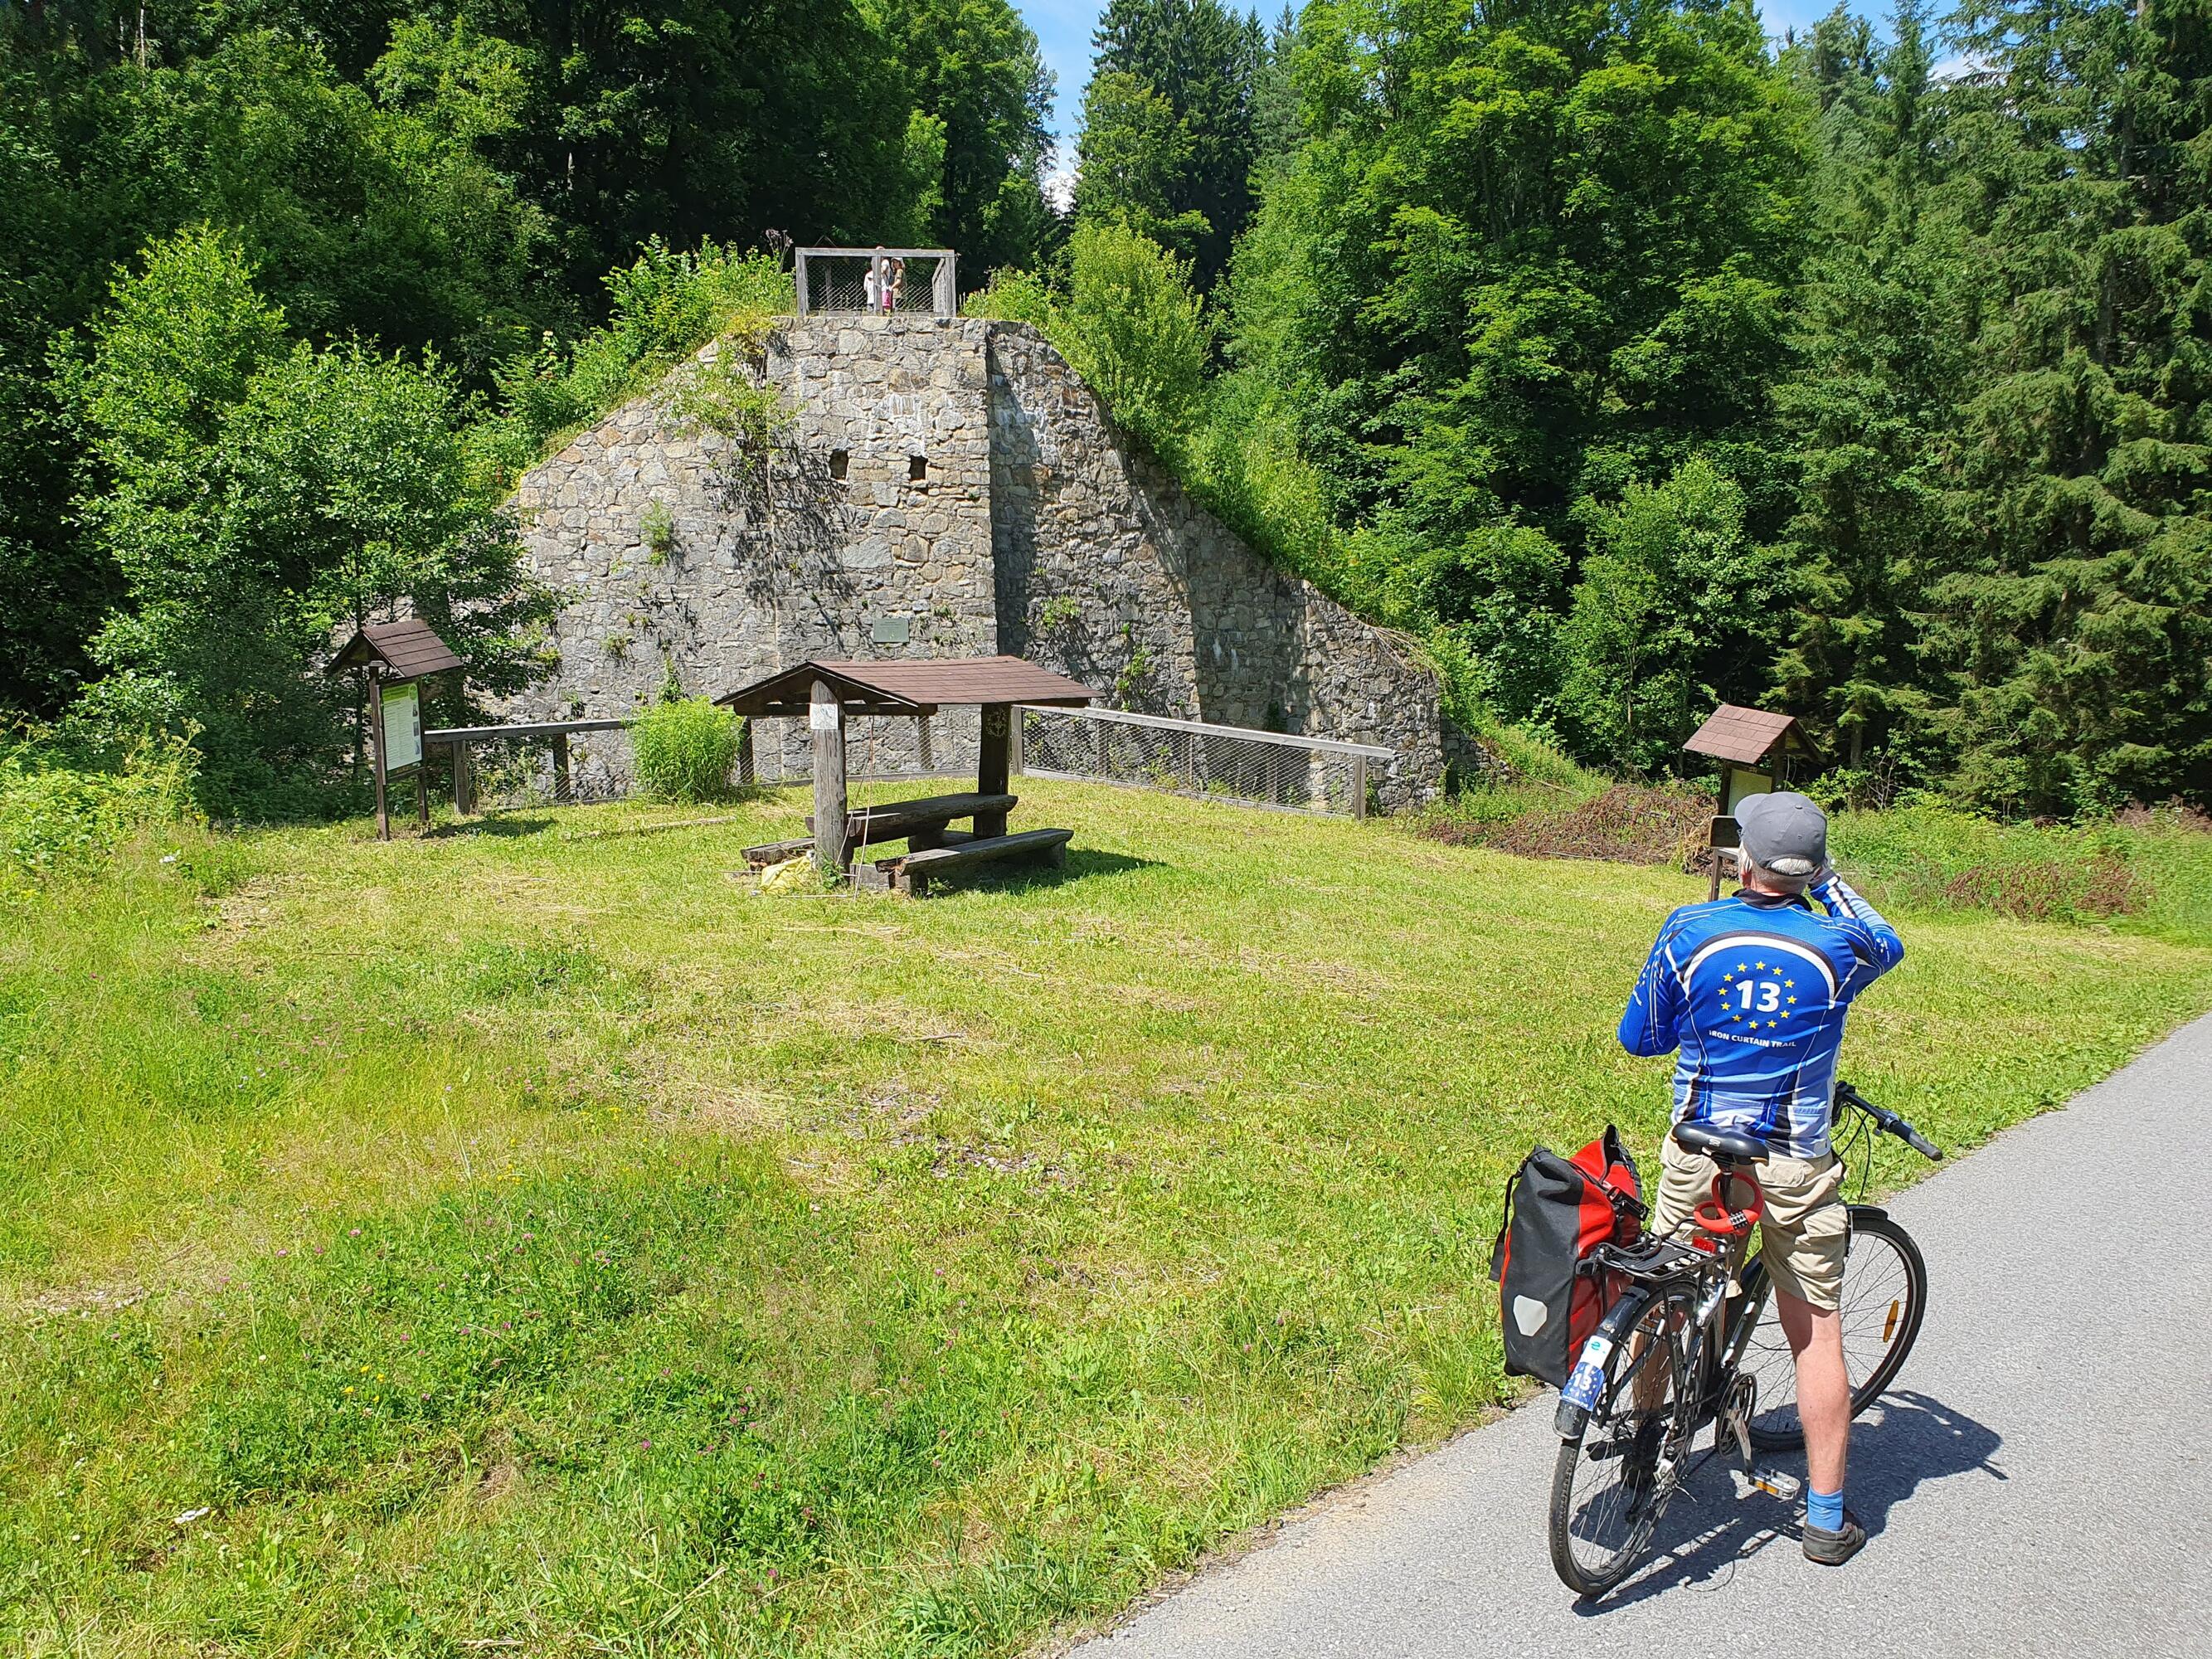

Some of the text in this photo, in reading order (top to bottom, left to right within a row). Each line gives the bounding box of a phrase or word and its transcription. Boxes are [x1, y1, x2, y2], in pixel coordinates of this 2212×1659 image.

[1735, 980, 1781, 1012] 13
[1709, 1030, 1729, 1040] IRON
[1731, 1034, 1770, 1048] CURTAIN
[1573, 1373, 1592, 1391] 13
